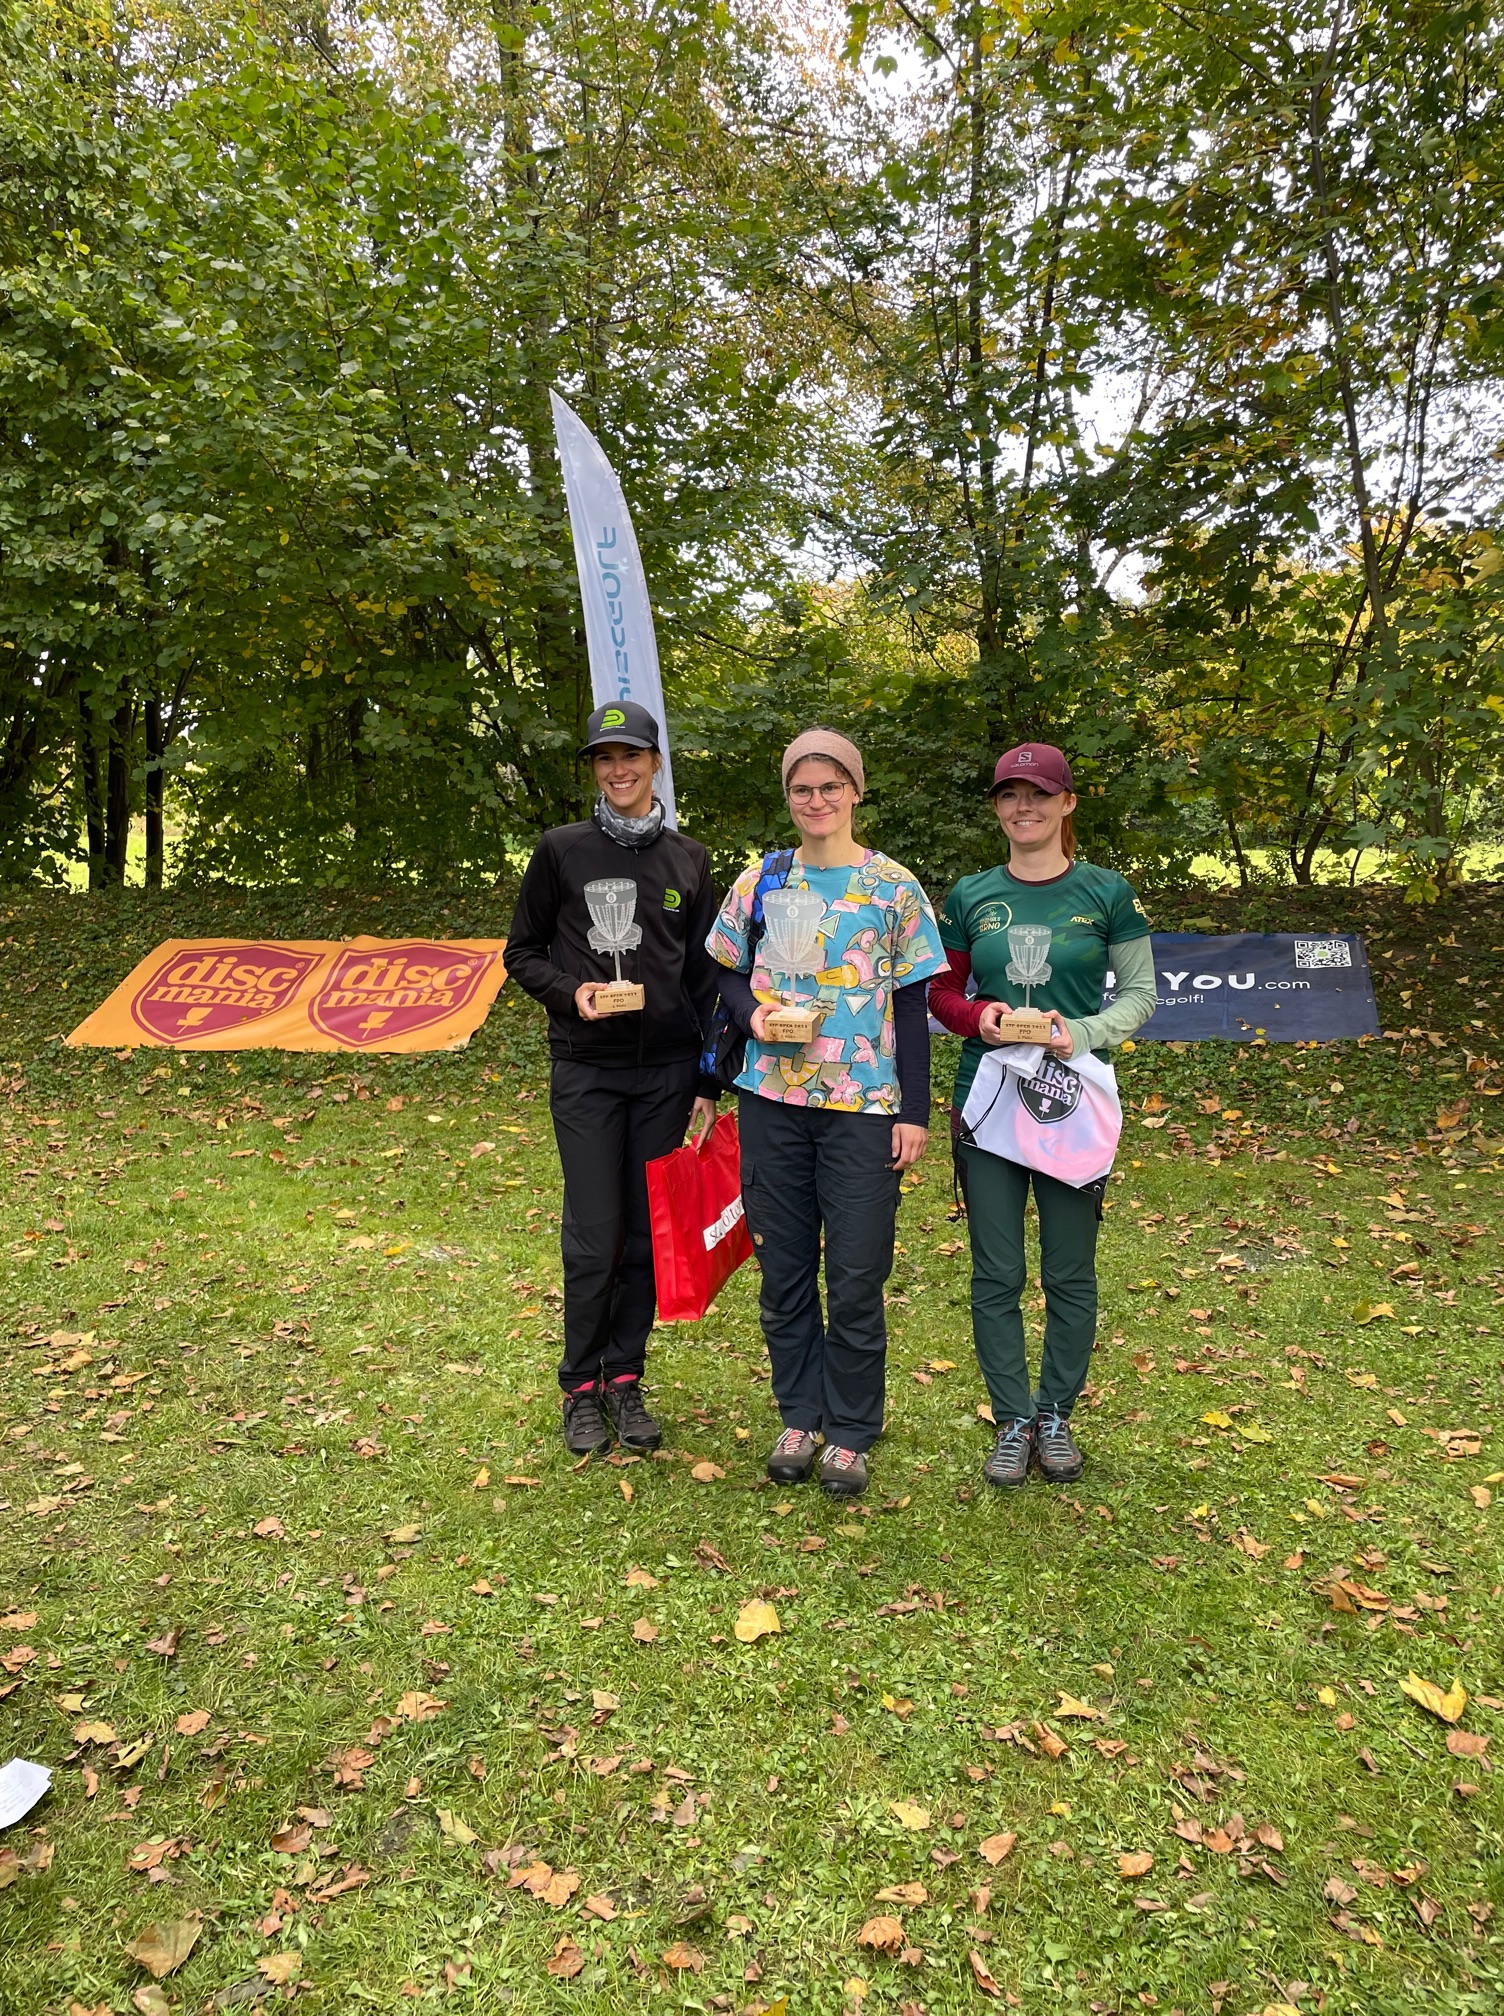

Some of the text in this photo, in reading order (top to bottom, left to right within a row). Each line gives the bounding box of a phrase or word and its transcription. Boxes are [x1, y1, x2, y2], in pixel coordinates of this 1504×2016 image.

[1070, 916, 1095, 926] ATEX
[167, 956, 299, 992] disc
[340, 957, 472, 991] disc
[146, 986, 277, 1009] mania
[322, 986, 455, 1008] mania
